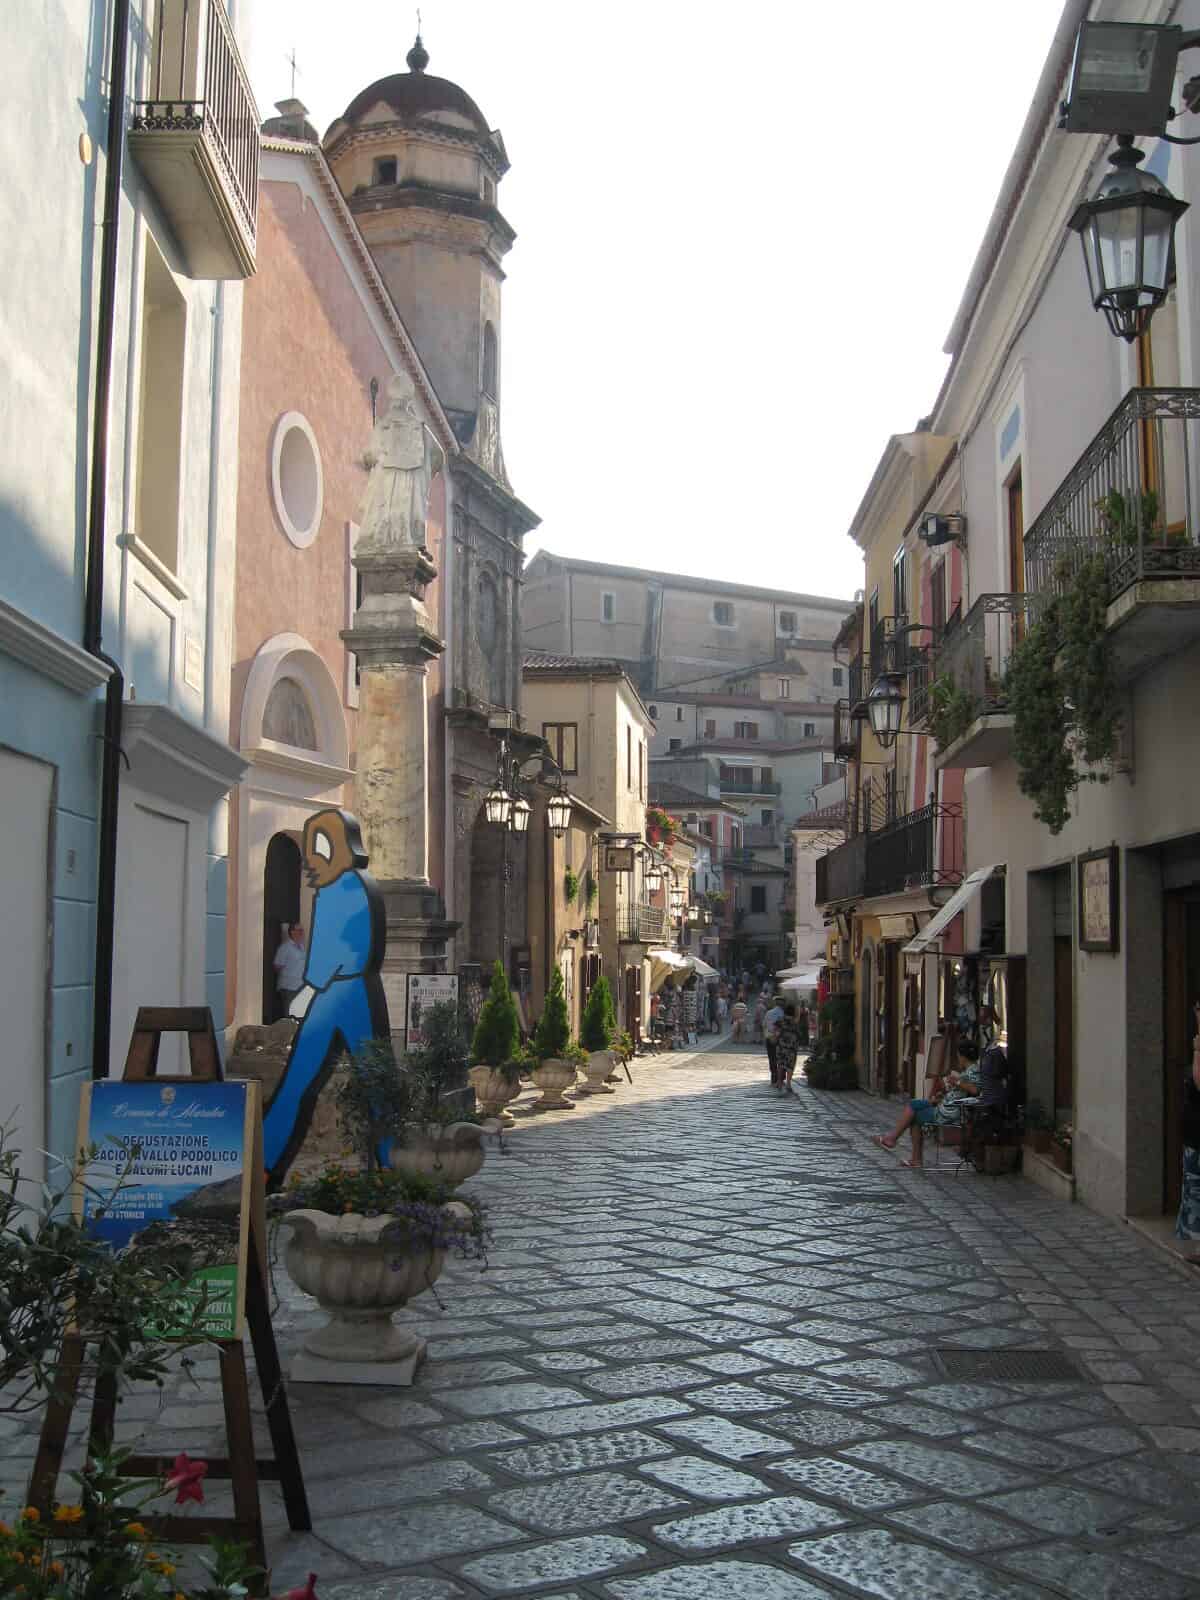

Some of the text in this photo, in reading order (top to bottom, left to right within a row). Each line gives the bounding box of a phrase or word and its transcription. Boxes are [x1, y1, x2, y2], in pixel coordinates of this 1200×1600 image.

[123, 1135, 209, 1147] DEGUSTAZIONE
[181, 1150, 238, 1162] PODOLICO
[115, 1164, 121, 1176] E
[172, 1164, 213, 1176] LUCANI
